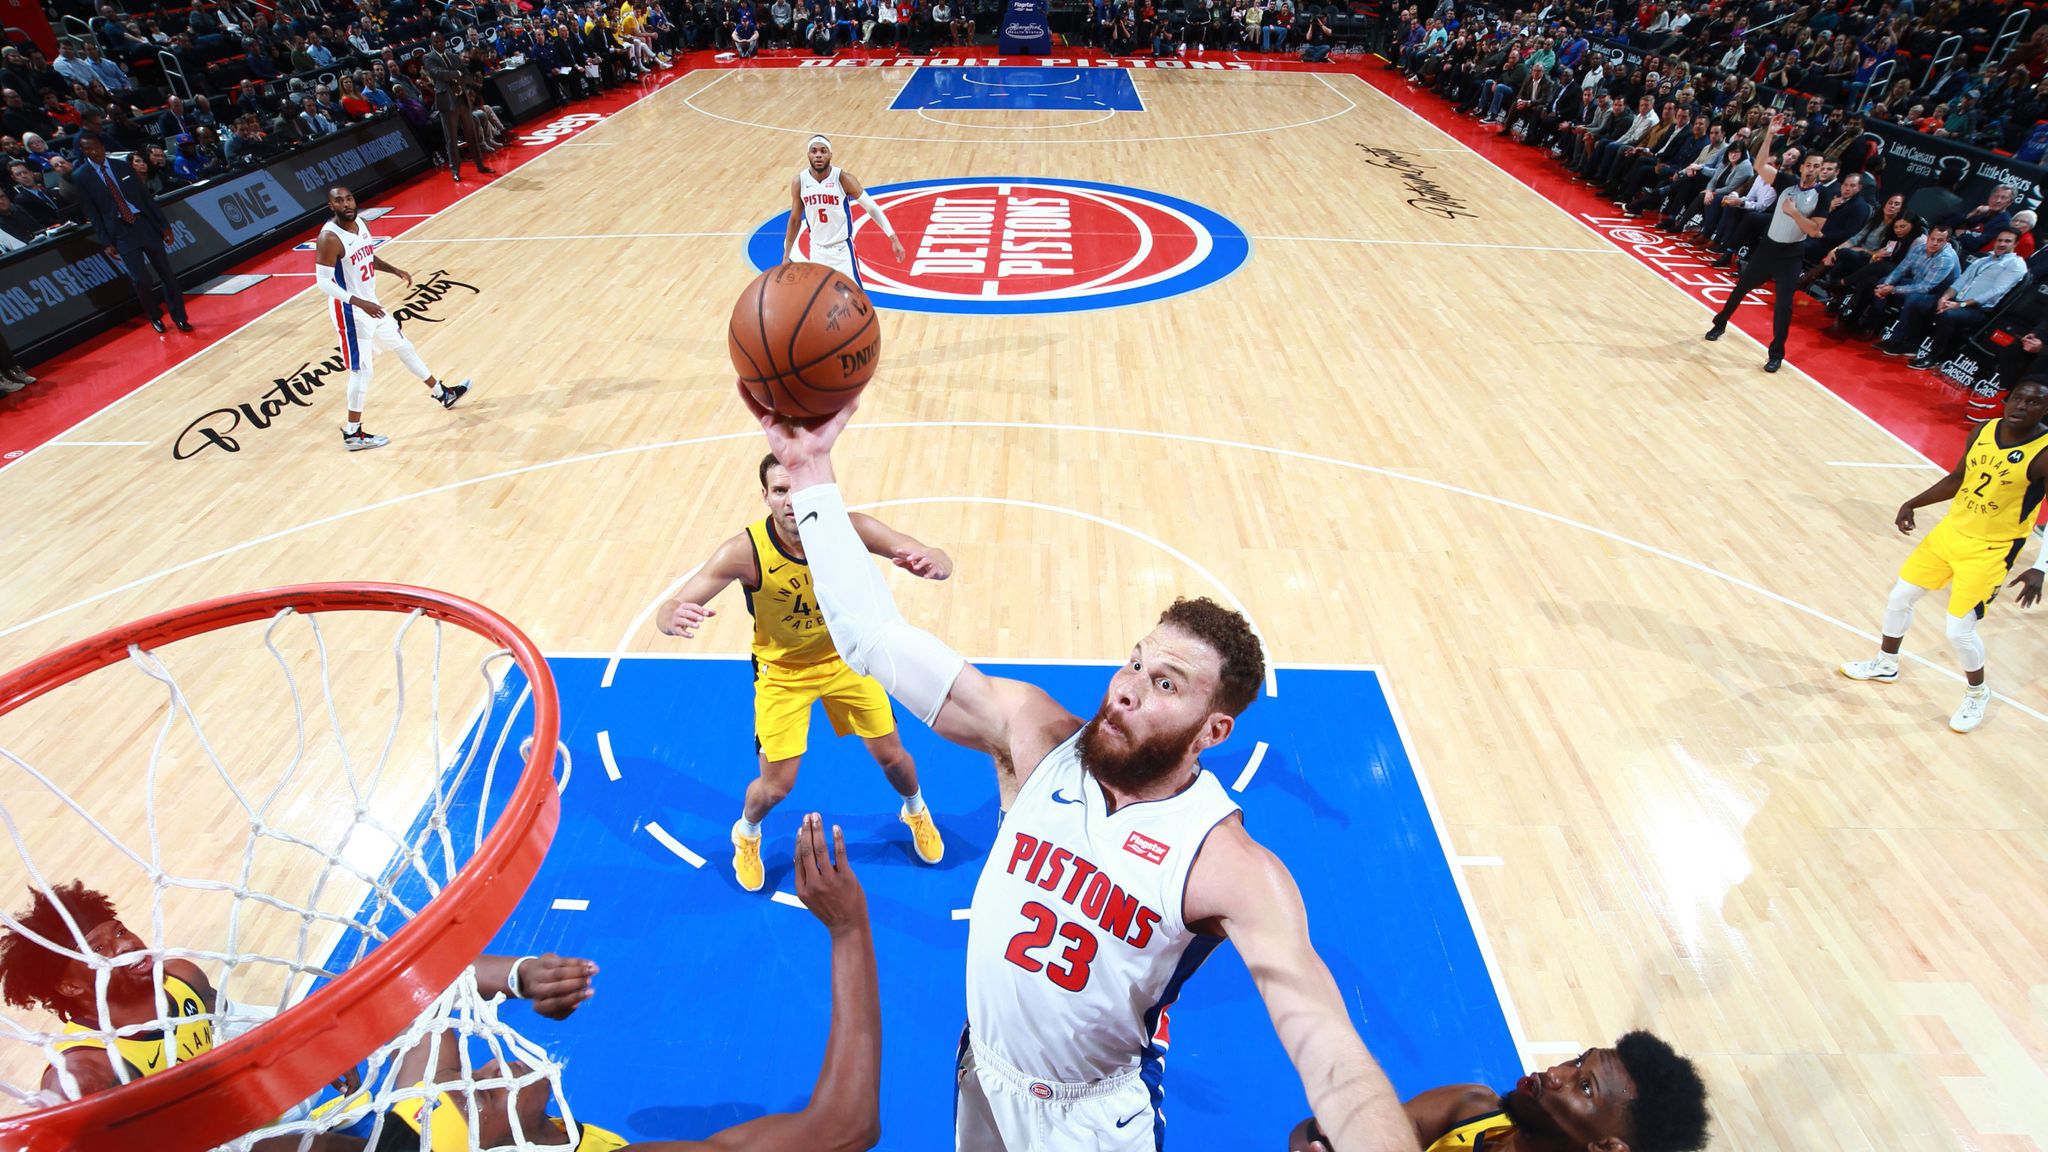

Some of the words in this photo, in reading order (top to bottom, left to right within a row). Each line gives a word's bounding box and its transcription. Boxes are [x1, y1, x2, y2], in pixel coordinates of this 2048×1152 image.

[799, 58, 1008, 67] DETROIT
[1036, 58, 1252, 70] PISTONS
[519, 113, 606, 146] Jeep
[1889, 141, 1909, 158] Little
[1907, 147, 1936, 165] Caesars
[295, 162, 338, 192] 2019-20
[329, 148, 366, 177] SEASON
[1906, 163, 1931, 176] arena
[1976, 162, 2000, 180] Little
[218, 182, 278, 231] ONE
[803, 194, 839, 206] PISTONS
[818, 208, 828, 223] 6
[909, 197, 997, 276] DETROIT
[998, 196, 1074, 277] PISTONS
[350, 244, 374, 265] PISTON
[52, 253, 119, 297] SEASON
[360, 261, 375, 281] 20
[393, 270, 480, 330] quity
[1940, 360, 1975, 386] Caesars
[1953, 353, 1979, 375] Little
[1975, 379, 1999, 398] Caes
[1966, 454, 2013, 486] INDIANA
[1973, 472, 1992, 498] 2
[773, 573, 809, 602] INDI
[793, 594, 820, 616] 4
[781, 615, 824, 629] PACE
[1129, 834, 1168, 855] Flagstar
[1006, 832, 1162, 949] PISTONS
[1004, 900, 1099, 993] 23
